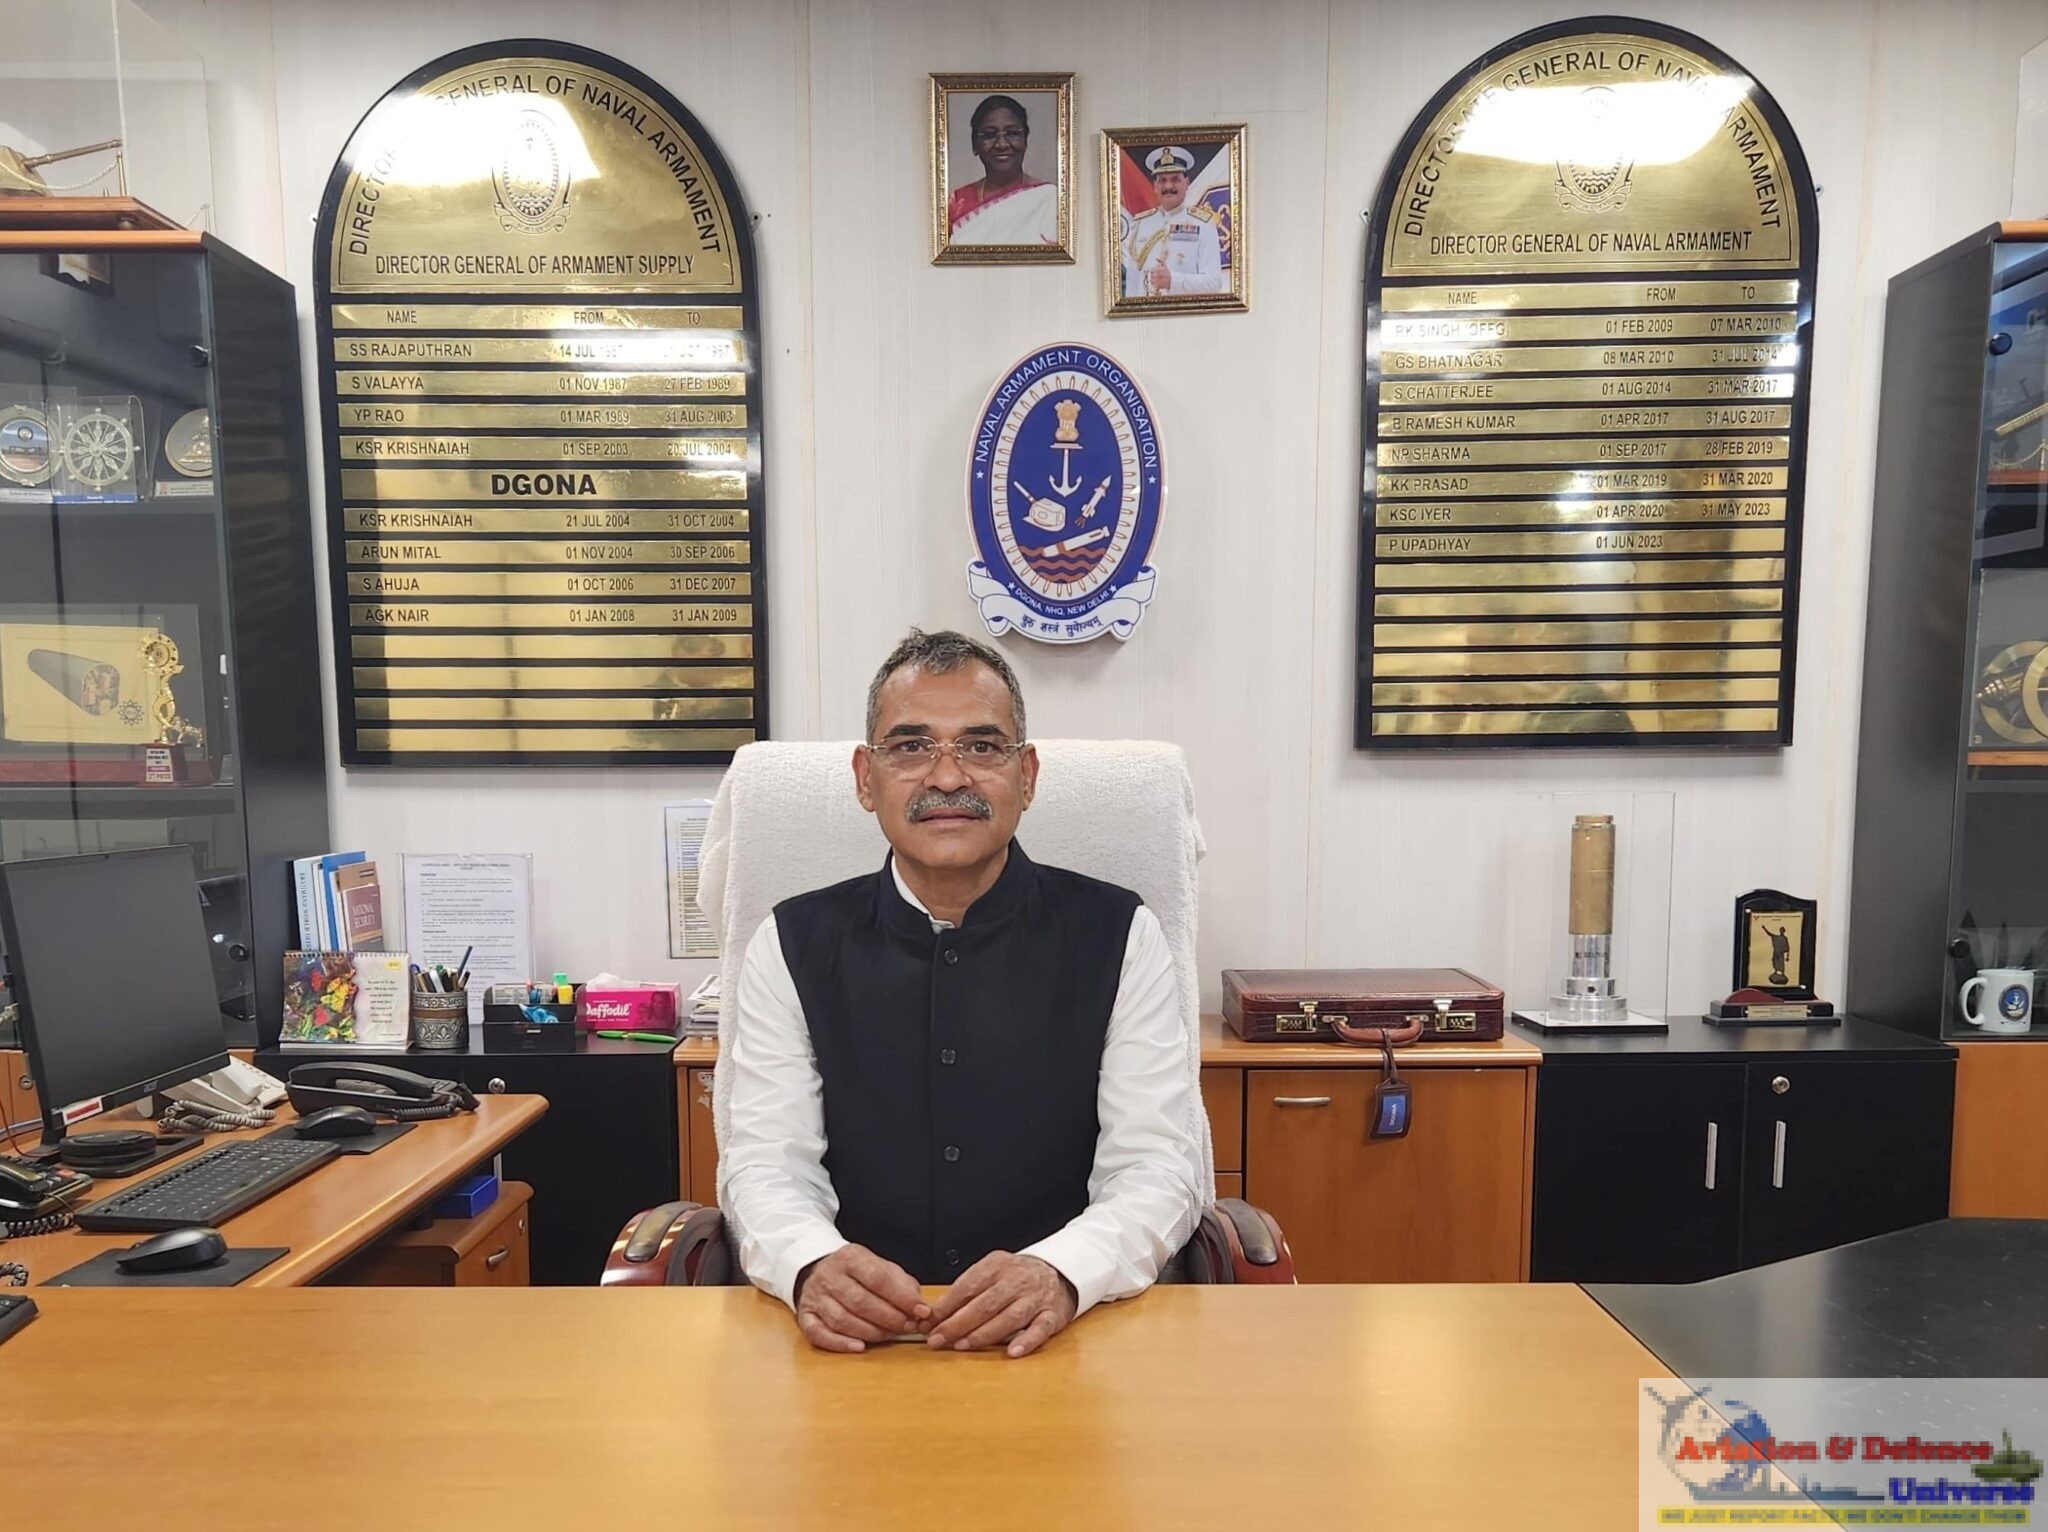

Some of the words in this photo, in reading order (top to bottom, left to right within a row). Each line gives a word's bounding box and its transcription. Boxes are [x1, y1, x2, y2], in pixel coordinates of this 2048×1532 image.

[1503, 51, 1610, 92] GENERAL
[1619, 52, 1650, 72] OF
[1720, 107, 1781, 228] ARMAMENT
[546, 75, 577, 96] OF
[582, 82, 647, 135] NAVAL
[648, 130, 721, 253] ARMAMENT
[1430, 235, 1507, 256] DIRECTOR
[1511, 234, 1584, 253] GENERAL
[1588, 233, 1609, 252] OF
[1613, 233, 1661, 251] NAVAL
[1665, 231, 1752, 251] ARMAMENT
[376, 255, 450, 275] DIRECTOR
[454, 255, 524, 275] GENERAL
[528, 255, 547, 274] OF
[551, 255, 635, 275] ARMAMENT
[638, 255, 694, 275] SUPPLY
[1447, 291, 1477, 305] NAME
[1646, 288, 1676, 301] FROM
[1741, 286, 1756, 299] TO
[386, 312, 418, 324] NAME
[574, 312, 604, 324] FROM
[687, 312, 701, 324] TO
[1605, 321, 1618, 333] 01
[1621, 320, 1644, 333] FEB
[1647, 319, 1673, 332] 2009
[1710, 319, 1723, 332] 07
[1726, 318, 1752, 331] MAR
[1756, 317, 1781, 330] 2010
[350, 343, 369, 357] SS
[371, 343, 472, 357] RAJAPUTHRAN
[1395, 356, 1414, 369] GS
[1418, 354, 1503, 368] BHATNAGAR
[1603, 352, 1616, 364] 08
[1619, 351, 1645, 364] MAR
[1649, 350, 1674, 363] 2010
[352, 377, 361, 390] S
[365, 377, 424, 390] VALAYYA
[559, 377, 571, 390] 01
[575, 377, 599, 390] NOV
[604, 377, 627, 390] 1987
[1394, 387, 1403, 400] S
[1406, 385, 1494, 399] CHATTERJEE
[1602, 383, 1613, 395] 01
[1617, 383, 1643, 395] AUG
[1646, 382, 1671, 394] 2014
[354, 410, 372, 423] YP
[374, 410, 405, 423] RAO
[560, 410, 572, 423] 01
[576, 410, 601, 423] MAR
[605, 410, 630, 423] 1989
[975, 411, 1003, 462] NAVAL
[996, 350, 1082, 410] ARMAMENT
[1086, 354, 1157, 468] ORGANISATION
[1393, 418, 1402, 430] B
[1405, 416, 1463, 430] RAMESH
[1466, 415, 1516, 429] KUMAR
[1601, 414, 1613, 426] 01
[1616, 414, 1640, 425] APR
[1643, 413, 1669, 425] 2017
[1706, 412, 1718, 424] 31
[1721, 411, 1747, 424] AUG
[1750, 410, 1775, 423] 2017
[355, 441, 383, 455] KSR
[387, 441, 469, 455] KRISHNAIAH
[563, 442, 574, 456] 01
[579, 442, 600, 456] SEP
[603, 442, 629, 456] 2003
[1391, 448, 1409, 461] NP
[1413, 447, 1471, 460] SHARMA
[1600, 445, 1612, 457] 01
[1616, 444, 1638, 456] SEP
[1641, 443, 1667, 456] 2017
[1705, 442, 1718, 455] 28
[1721, 442, 1744, 454] FEB
[1748, 441, 1773, 454] 2019
[491, 473, 598, 496] DGONA
[1391, 479, 1409, 491] KK
[1413, 478, 1469, 491] PRASAD
[1597, 475, 1609, 488] 01
[1612, 475, 1639, 487] MAR
[1641, 474, 1667, 486] 2019
[1702, 473, 1715, 486] 31
[1718, 472, 1744, 486] MAR
[1747, 471, 1773, 485] 2020
[359, 513, 387, 527] KSR
[389, 513, 473, 527] KRISHNAIAH
[566, 513, 578, 527] 21
[581, 513, 601, 527] JUL
[603, 513, 630, 527] 2004
[667, 513, 680, 527] 31
[682, 513, 707, 527] OCT
[710, 513, 735, 527] 2004
[1390, 509, 1417, 521] KSC
[1421, 508, 1451, 521] IYER
[1596, 505, 1609, 518] 01
[1610, 504, 1636, 518] APR
[1638, 503, 1665, 517] 2020
[1702, 504, 1714, 517] 31
[1717, 503, 1744, 516] MAY
[1745, 502, 1771, 515] 2023
[362, 546, 400, 559] ARUN
[403, 546, 442, 559] MITAL
[565, 546, 577, 559] 01
[576, 546, 604, 559] NOV
[606, 546, 633, 559] 2004
[670, 546, 682, 559] 30
[684, 546, 707, 559] SEP
[710, 546, 735, 559] 2006
[1389, 539, 1398, 551] P
[1401, 538, 1472, 551] UPADHYAY
[1596, 537, 1608, 549] 01
[1611, 536, 1636, 548] JUN
[1638, 535, 1663, 548] 2023
[363, 578, 372, 591] S
[375, 578, 420, 591] AHUJA
[567, 578, 579, 591] 01
[582, 578, 607, 591] OCT
[610, 578, 634, 591] 2006
[669, 578, 682, 591] 31
[684, 578, 709, 591] DEC
[711, 578, 736, 591] 2007
[1067, 604, 1087, 615] NEW
[1087, 590, 1110, 609] DELHI
[365, 609, 394, 622] AGK
[397, 609, 429, 622] NAIR
[569, 609, 581, 622] 01
[584, 609, 608, 622] JAN
[610, 609, 635, 622] 2008
[672, 609, 685, 622] 31
[687, 609, 710, 622] JAN
[712, 609, 737, 622] 2009
